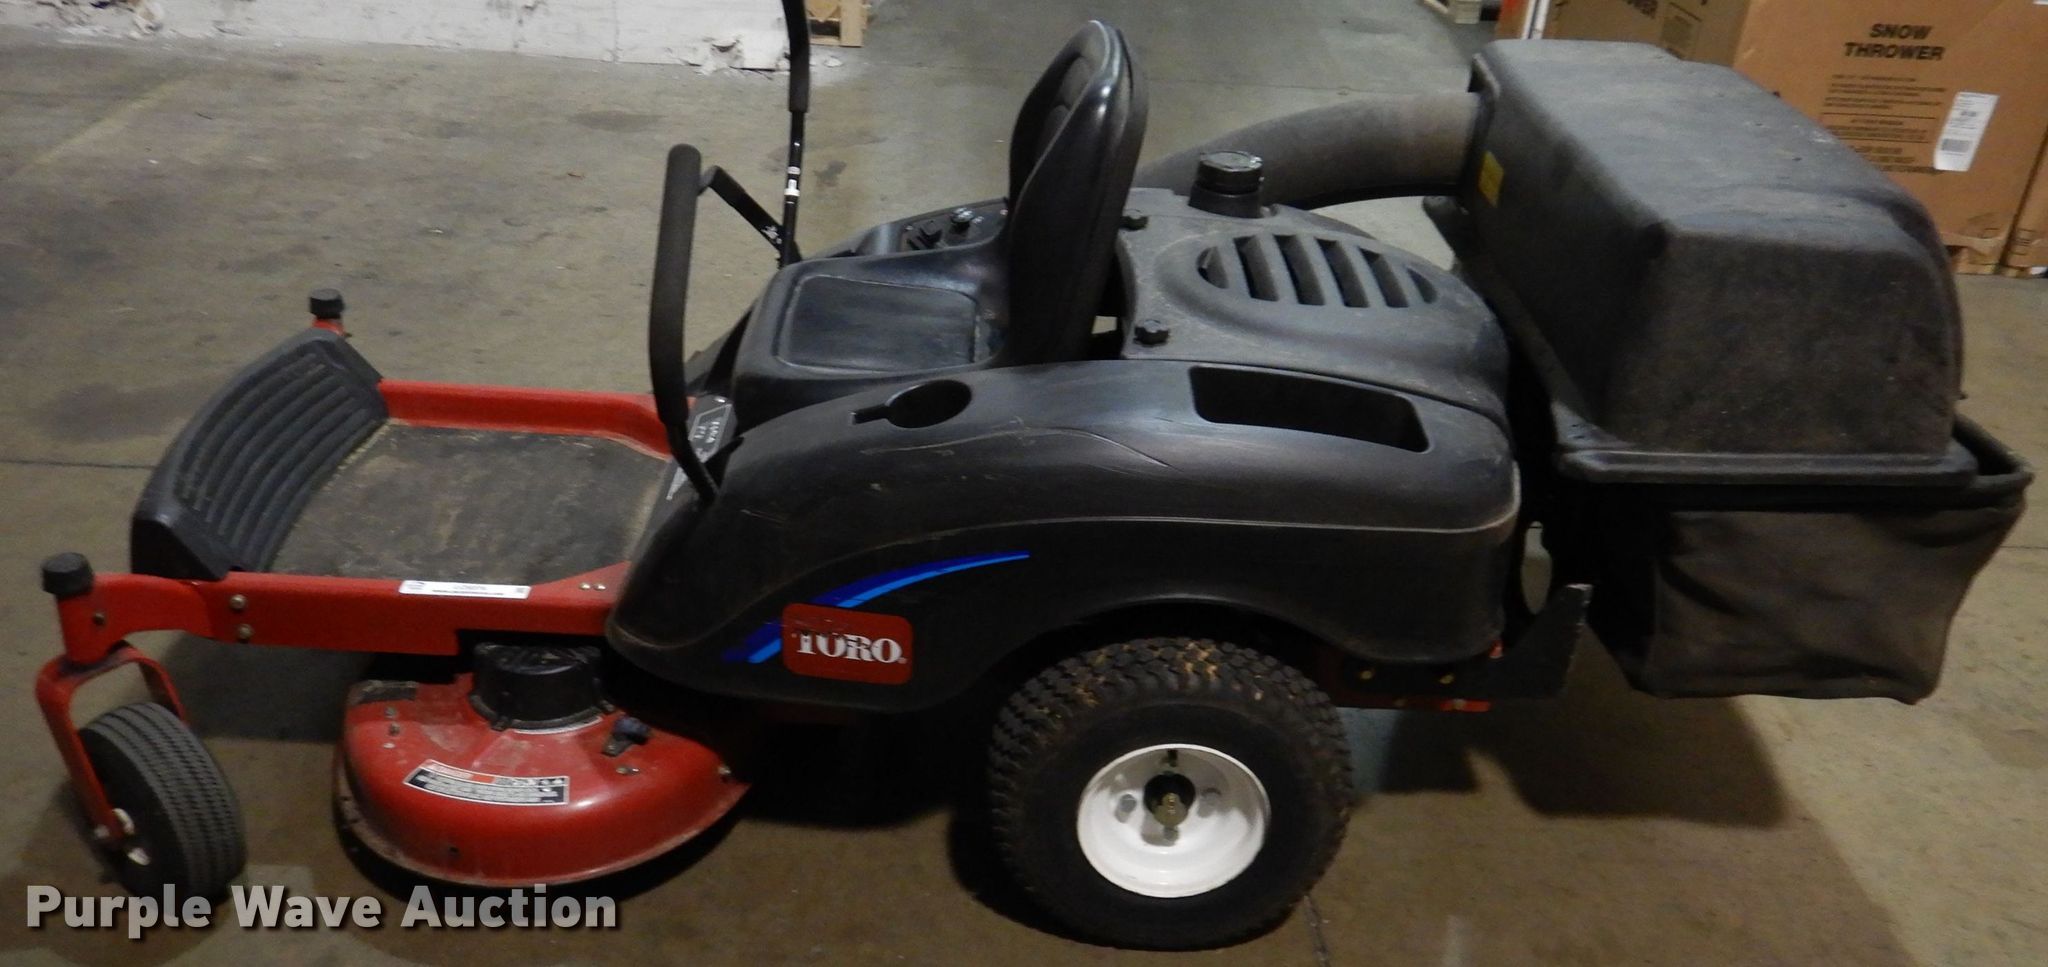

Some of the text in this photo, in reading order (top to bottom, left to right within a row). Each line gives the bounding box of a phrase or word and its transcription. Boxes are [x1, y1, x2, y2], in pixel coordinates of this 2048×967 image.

[1869, 23, 1932, 40] SNOW
[1844, 42, 1945, 60] THROWER
[792, 632, 903, 664] TORO
